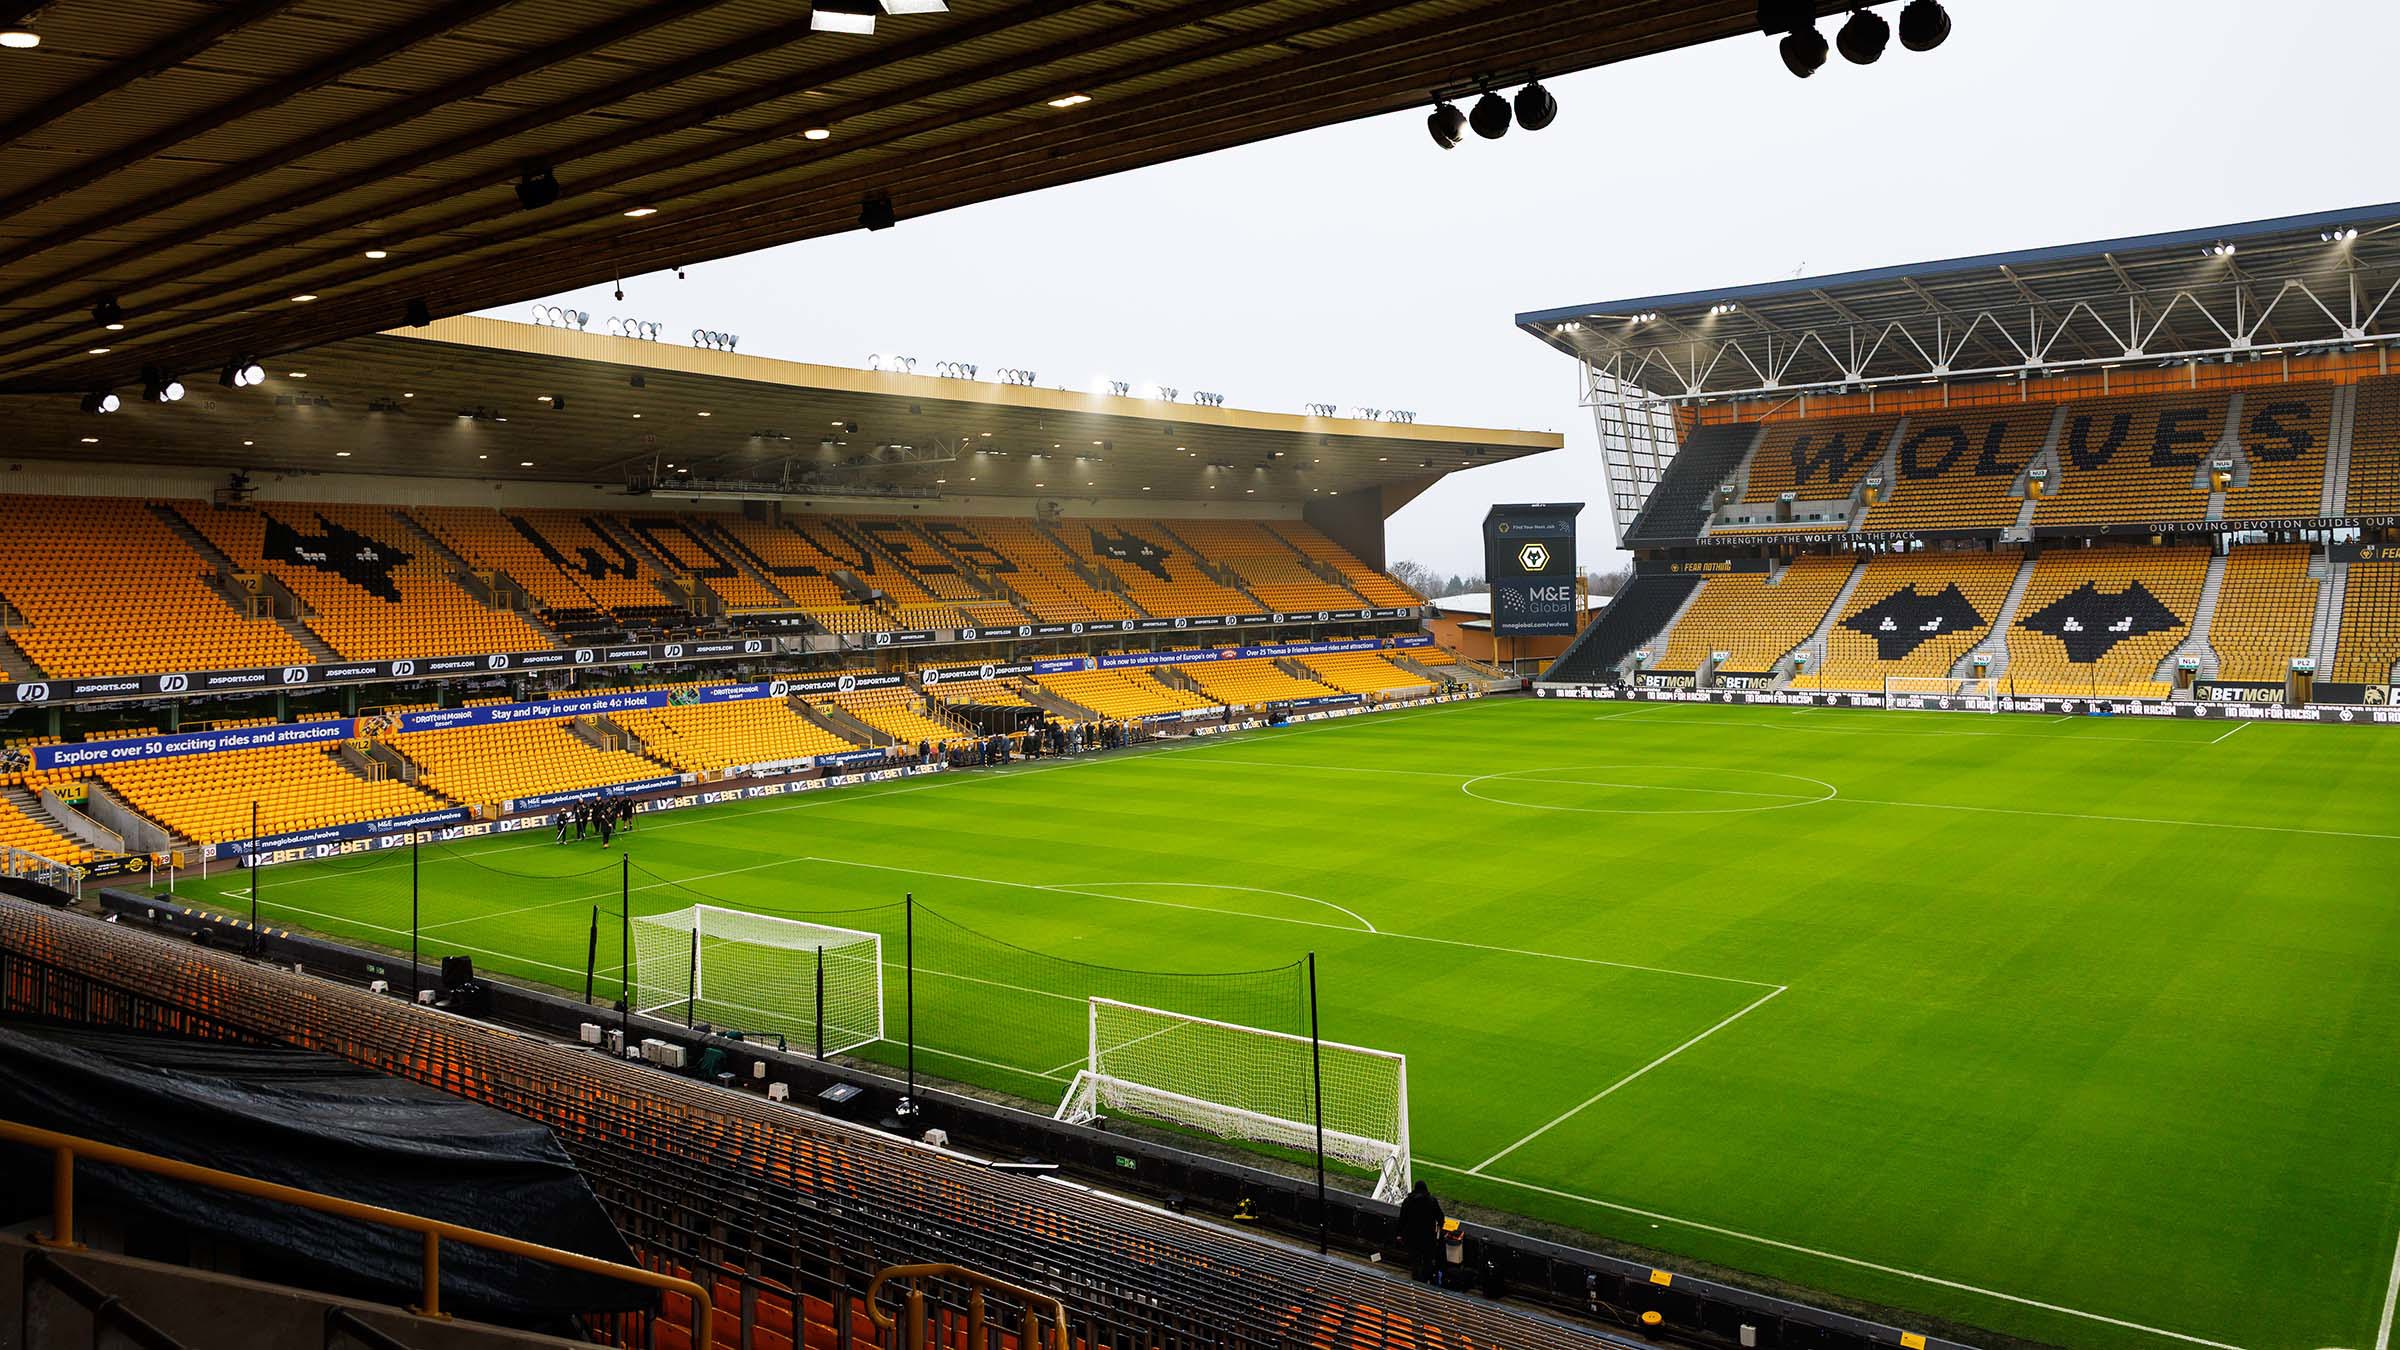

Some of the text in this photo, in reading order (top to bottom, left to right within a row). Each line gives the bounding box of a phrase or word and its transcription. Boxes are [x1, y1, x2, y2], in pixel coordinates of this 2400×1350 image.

[1789, 400, 2313, 484] WOLVES
[2149, 516, 2394, 532] OUR LOVING DEVOTION GUIDES OUR
[1715, 535, 1763, 545] STRENGTH
[1766, 535, 1779, 543] OF
[1782, 535, 1800, 543] THE
[1804, 534, 1833, 542] WOLF
[1836, 534, 1847, 542] IS
[1851, 533, 1863, 541] IN
[1867, 532, 1885, 540] THE
[1889, 531, 1915, 540] PACK
[507, 514, 1018, 584] WOLVES
[1684, 561, 1731, 572] FEAR NOTHING
[1529, 586, 1570, 601] M&E
[1529, 602, 1571, 613] Global
[1019, 625, 1031, 636] JD
[1071, 622, 1083, 633] JD
[1122, 620, 1133, 630] JD
[876, 633, 890, 645] JD
[963, 629, 976, 640] JD
[665, 644, 682, 657] JD
[696, 645, 734, 653] JDSPORTS.COM
[745, 640, 761, 653] JD
[1267, 647, 1286, 655] Thomas
[522, 655, 563, 664] JDSPORTS.COM
[576, 650, 592, 663] JD
[608, 650, 648, 658] JDSPORTS.COM
[1102, 657, 1116, 666] Book
[1117, 657, 1129, 665] now
[1130, 656, 1136, 664] to
[1137, 655, 1149, 663] visit
[1149, 655, 1159, 663] the
[1160, 654, 1174, 662] home
[1175, 653, 1182, 661] of
[1183, 652, 1205, 662] Europe's
[1205, 652, 1217, 660] only
[393, 661, 413, 676] JD
[429, 660, 476, 670] JDSPORTS.COM
[490, 655, 507, 669] JD
[284, 668, 307, 683] JD
[325, 667, 376, 677] JDSPORTS.COM
[925, 670, 937, 683] JD
[939, 670, 979, 680] JDSPORTS.COM
[982, 666, 994, 678] JD
[995, 665, 1033, 675] JDSPORTS.COM
[162, 674, 187, 692] JD
[208, 674, 265, 684] JDSPORTS.COM
[840, 677, 853, 691] JD
[856, 676, 900, 686] JDSPORTS.COM
[1646, 675, 1695, 687] BETMGM
[20, 684, 46, 701] JD
[75, 682, 139, 693] JDSPORTS.COM
[771, 682, 787, 696] JD
[788, 681, 836, 692] JDSPORTS.COM
[1647, 691, 1711, 701] NO ROOM FOR RACISM
[1745, 694, 1813, 704] NO ROOM FOR RACISM
[1851, 697, 1860, 705] NO
[1861, 697, 1881, 706] ROOM
[2211, 688, 2285, 702] BETMGM
[491, 696, 648, 721] Stay and Play in our on site Hotel
[1965, 700, 1976, 708] NO
[1998, 701, 2015, 710] FOR
[2014, 701, 2045, 712] RACISM
[2126, 704, 2142, 714] FOR
[2143, 704, 2176, 716] RACISM
[2225, 707, 2237, 717] NO
[2239, 708, 2264, 718] ROOM
[2264, 708, 2283, 719] FOR
[2284, 708, 2320, 720] RACISM
[2373, 711, 2387, 722] NO
[54, 725, 340, 765] Explore over 50 exciting rides and attractions
[749, 784, 787, 797] DEBET
[791, 778, 827, 792] DEBET
[53, 786, 82, 799] WL1
[703, 790, 743, 804] DEBET
[658, 795, 698, 811] DEBET
[377, 819, 393, 829] M&E
[393, 811, 462, 828] mneglobal.com/wolves
[500, 815, 548, 832] DEBET
[442, 821, 493, 840] DEBET
[261, 829, 340, 848] mneglobal.com/wolves
[381, 830, 433, 848] DEBET
[205, 848, 216, 856] 30
[316, 838, 372, 858] DEBET
[160, 854, 170, 863] 29
[247, 848, 306, 867] DEBET
